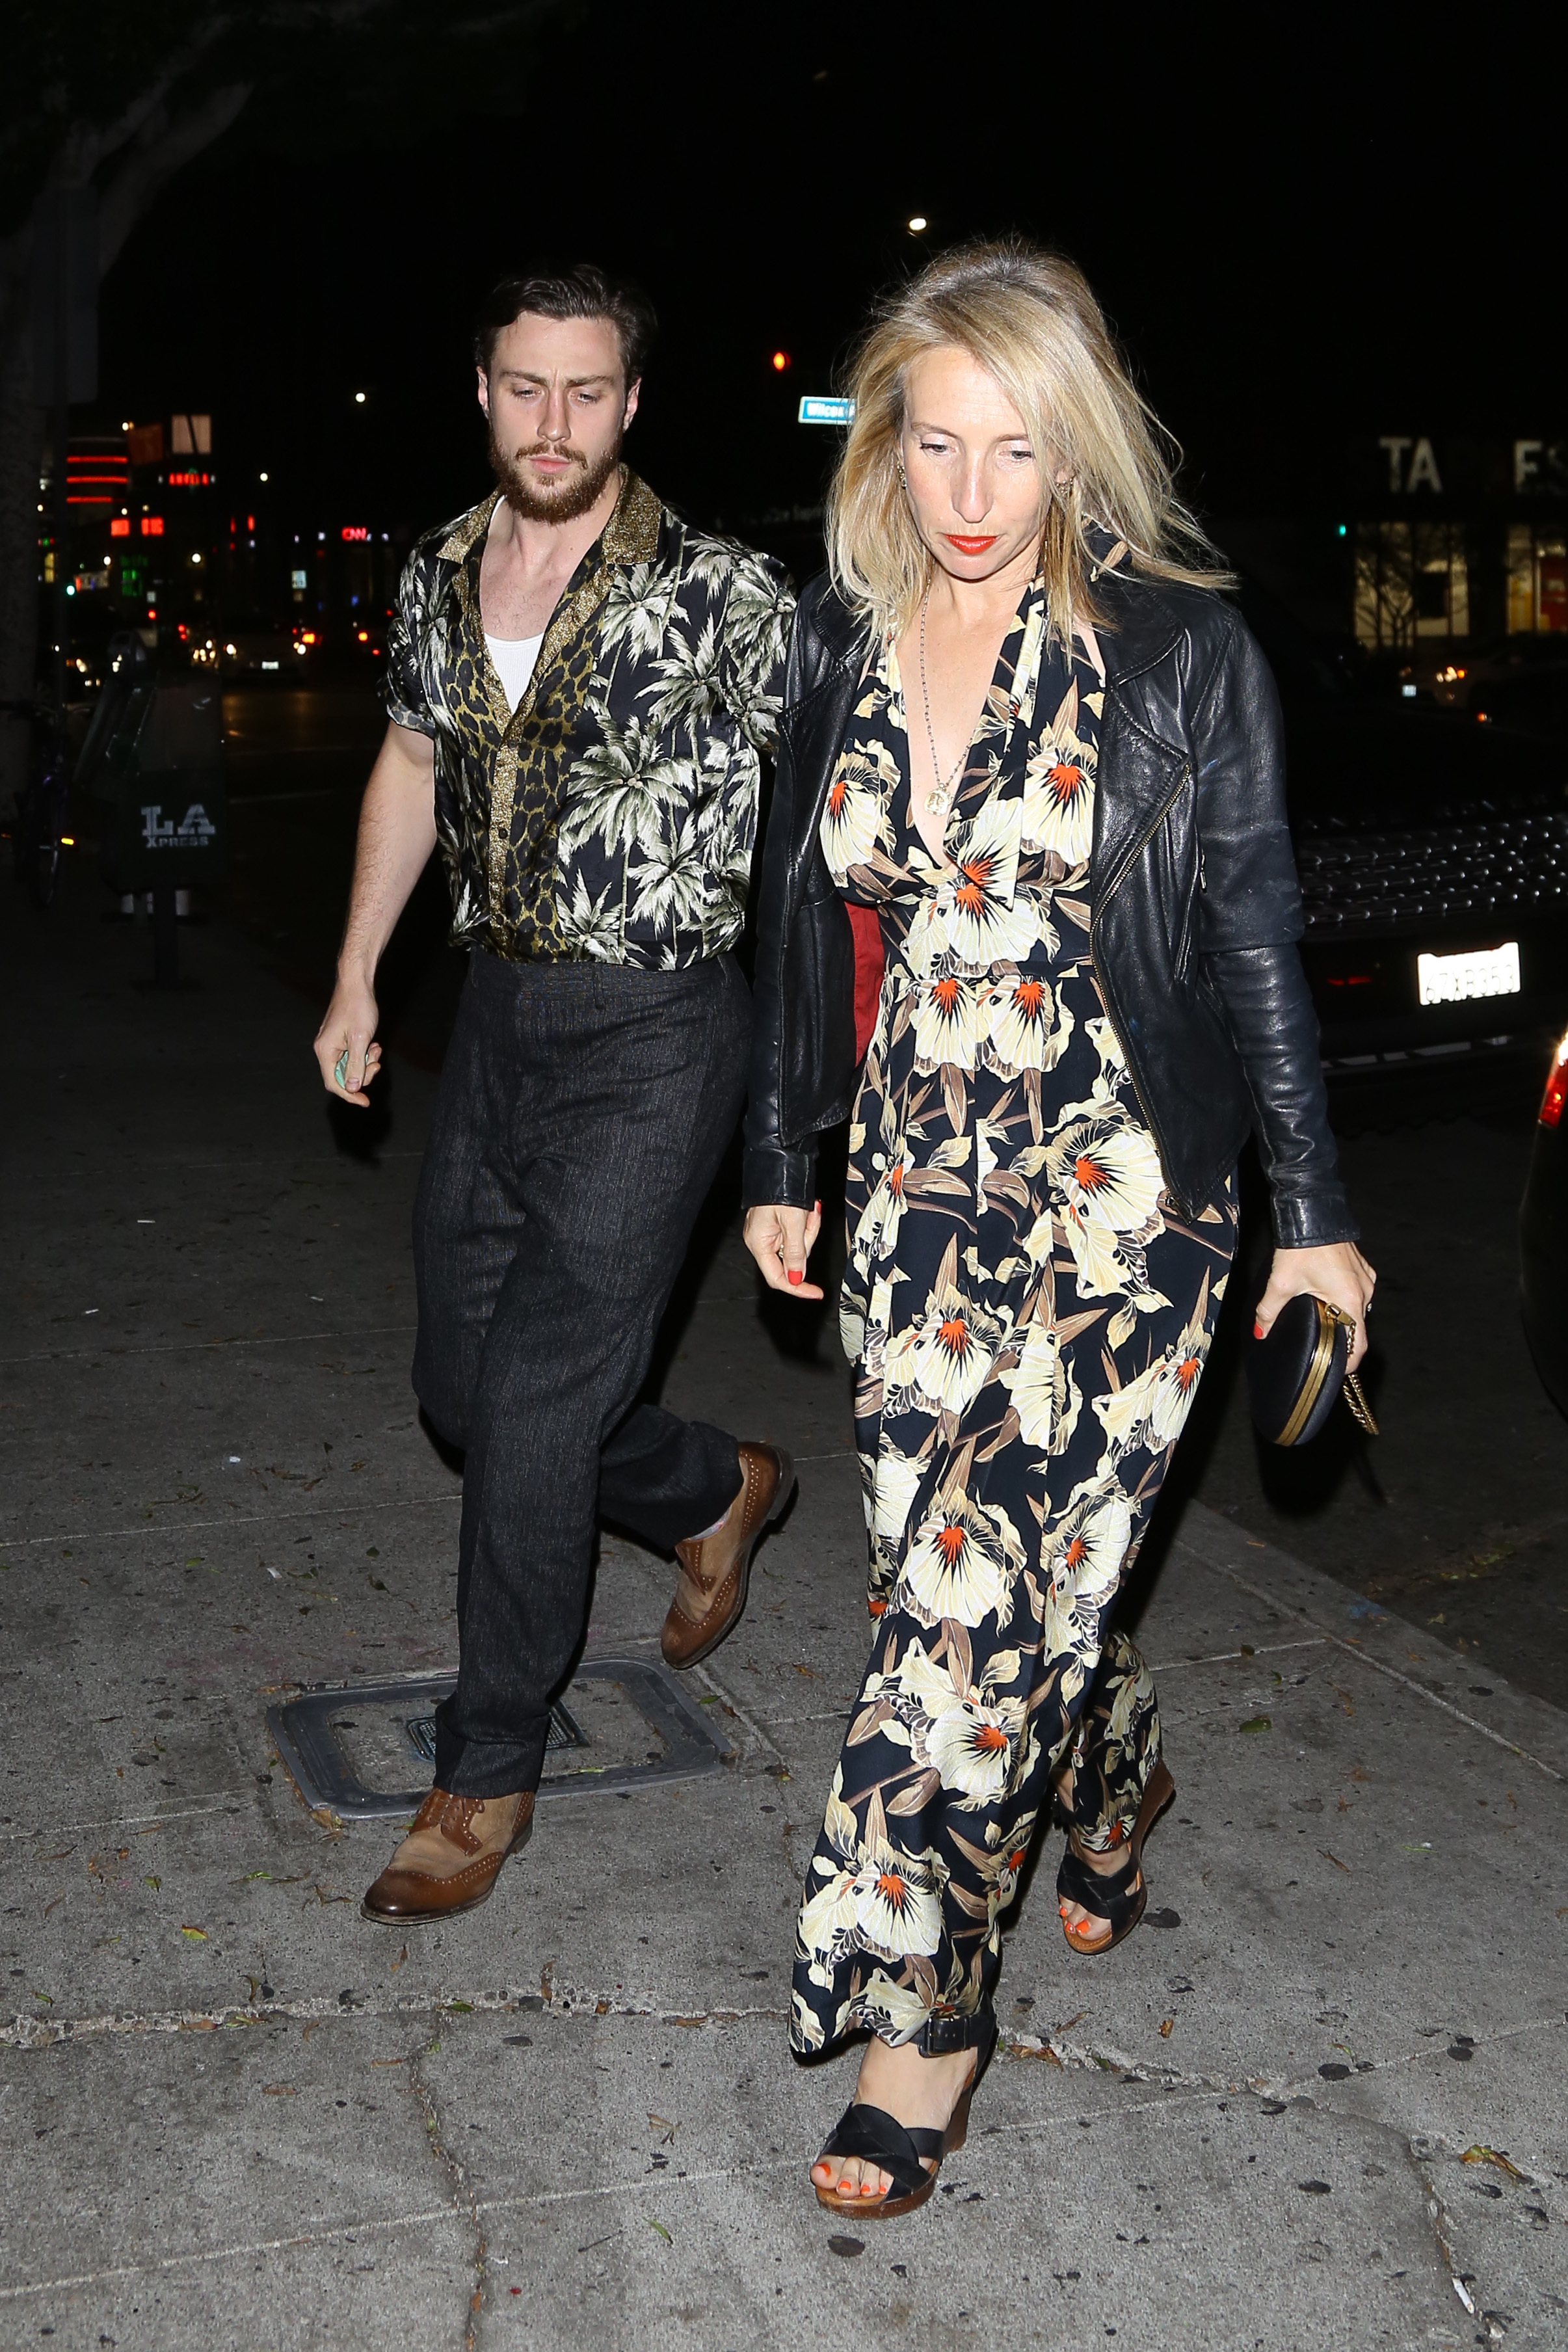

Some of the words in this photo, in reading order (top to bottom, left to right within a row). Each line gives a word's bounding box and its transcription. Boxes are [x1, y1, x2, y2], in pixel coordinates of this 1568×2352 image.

[341, 526, 367, 541] CNN
[140, 803, 216, 836] LA
[146, 835, 209, 848] XPRESS
